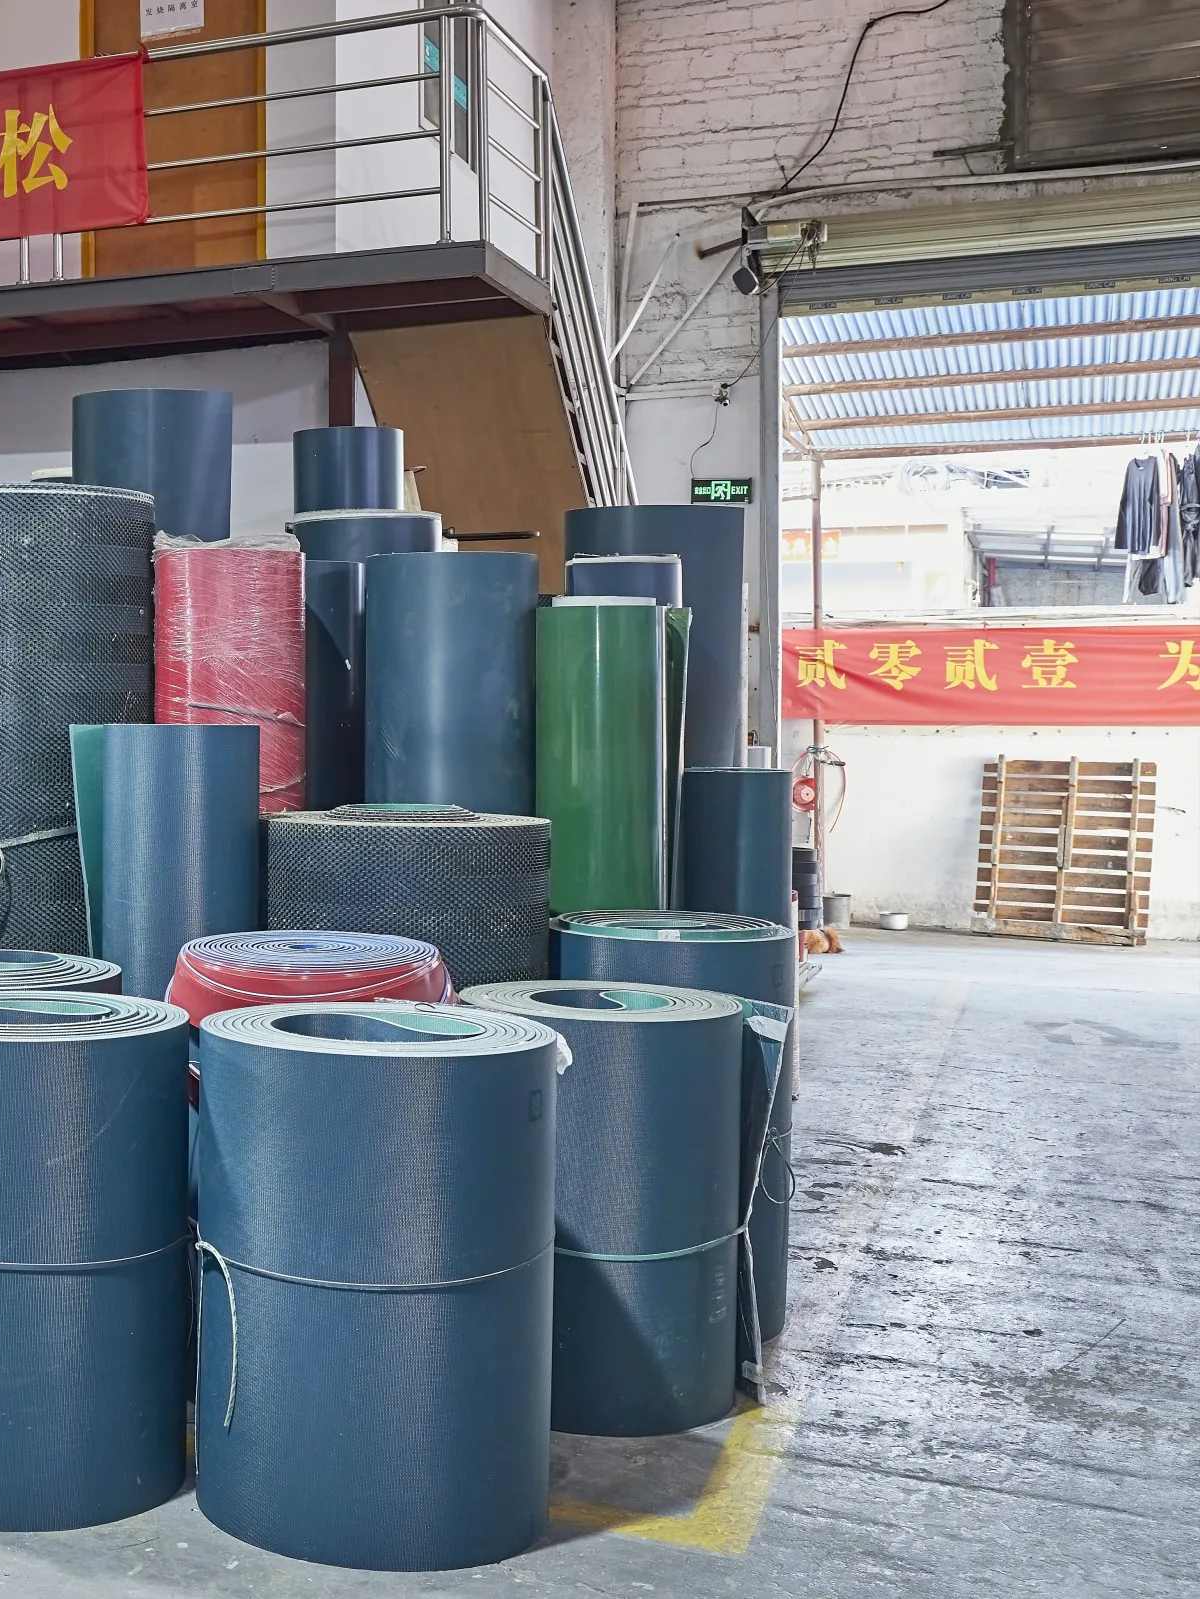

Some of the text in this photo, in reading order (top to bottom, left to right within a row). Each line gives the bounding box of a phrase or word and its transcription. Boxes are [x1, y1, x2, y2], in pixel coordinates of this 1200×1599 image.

[145, 0, 199, 16] 发烧隔离室
[731, 486, 749, 494] EXIT
[796, 639, 1079, 692] 贰零贰壹
